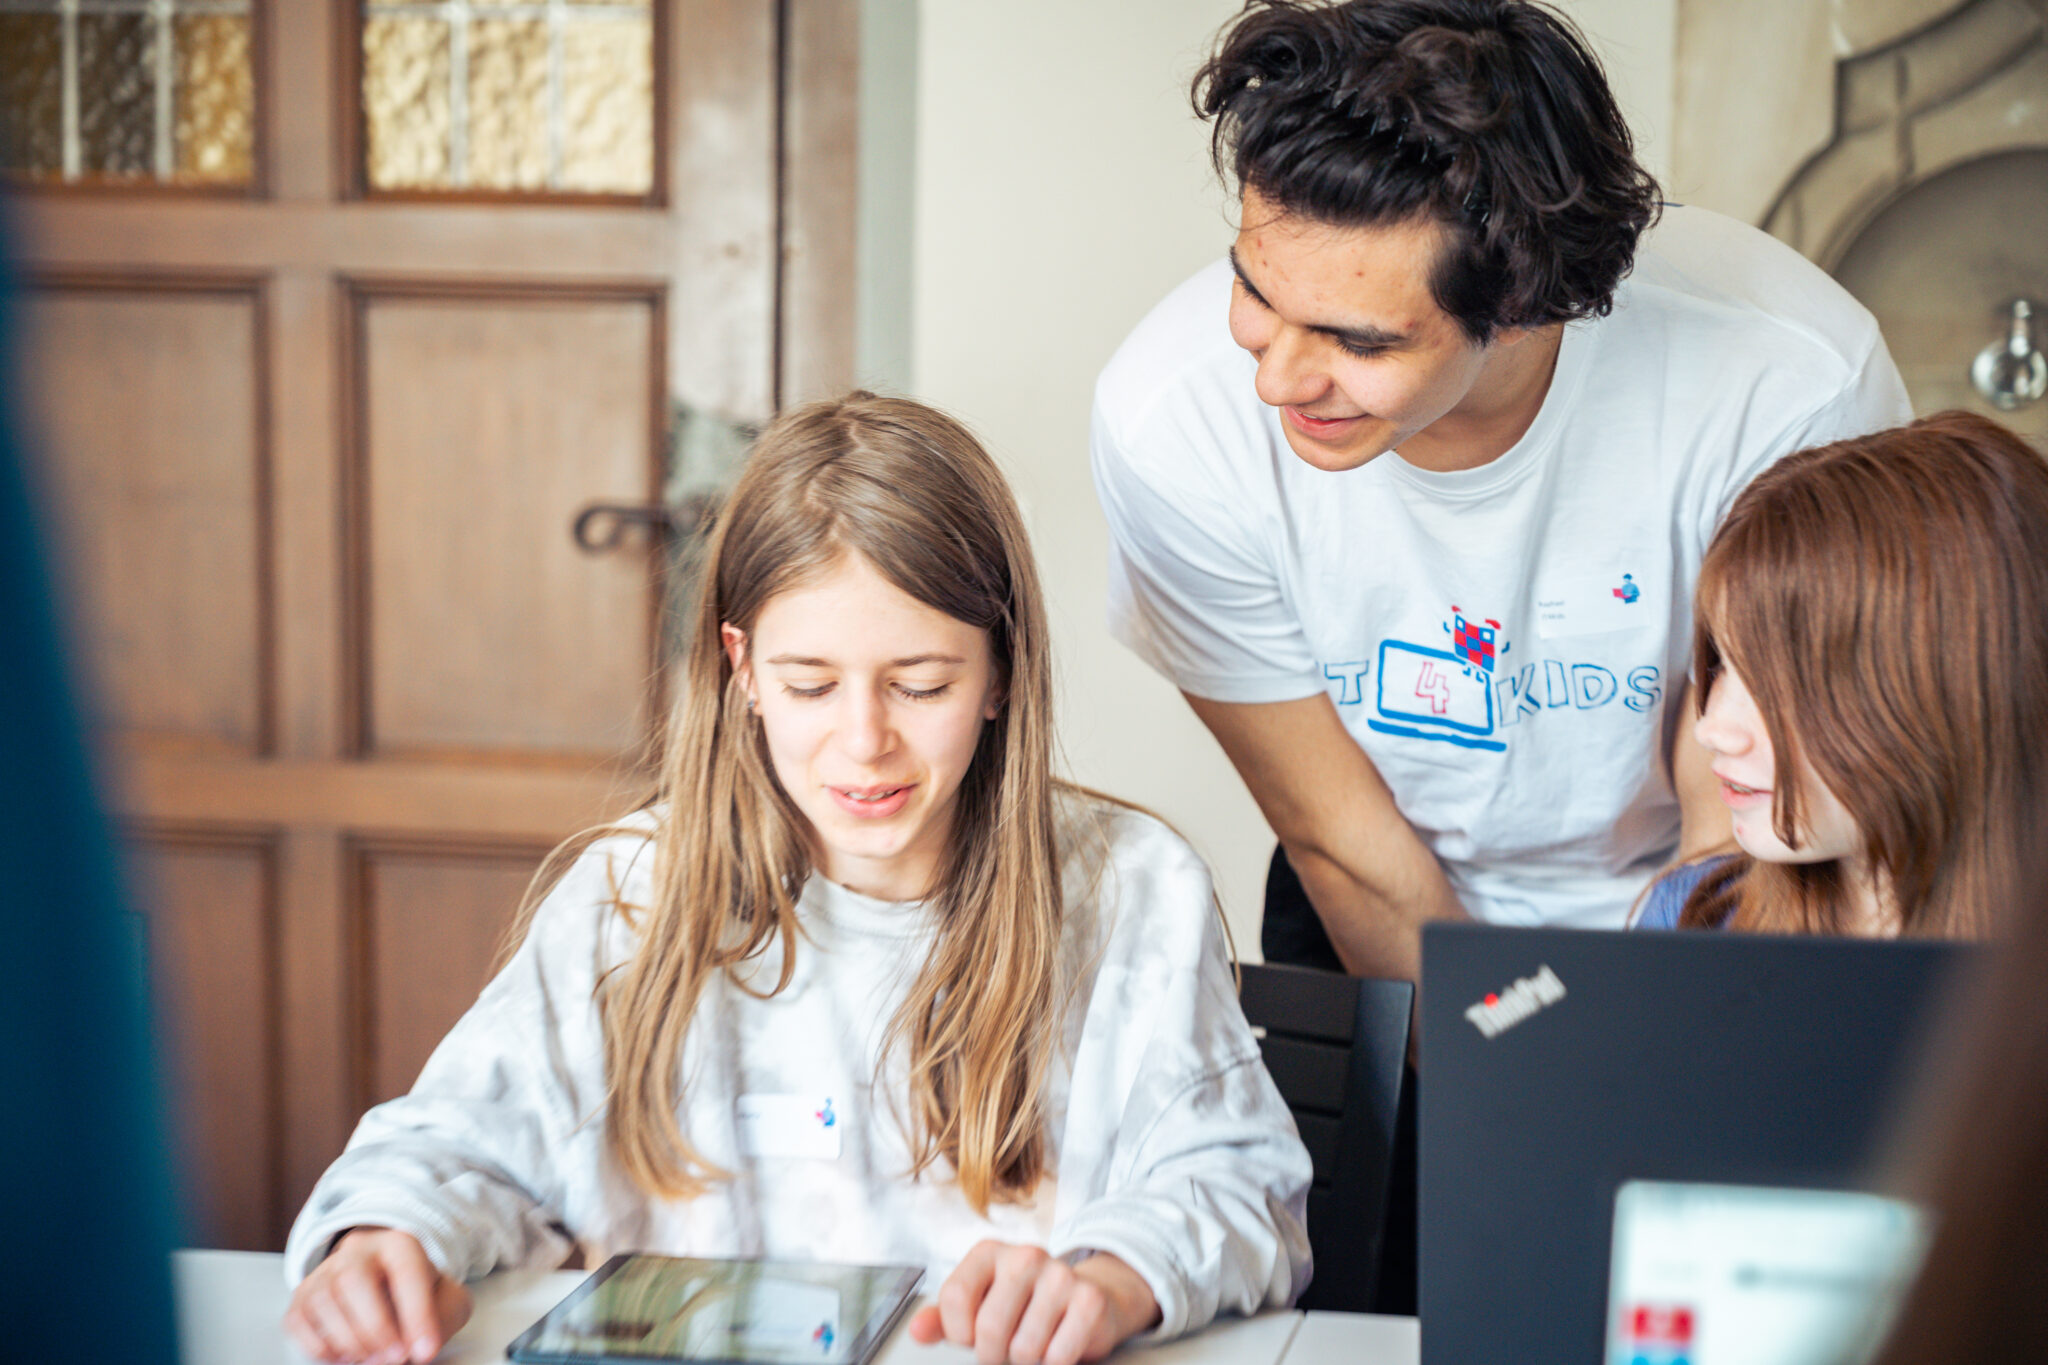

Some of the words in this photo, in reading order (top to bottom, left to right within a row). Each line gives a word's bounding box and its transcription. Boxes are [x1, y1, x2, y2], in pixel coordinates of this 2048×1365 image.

[1315, 659, 1370, 705] T
[1414, 661, 1451, 714] 4
[1495, 659, 1663, 728] KIDS
